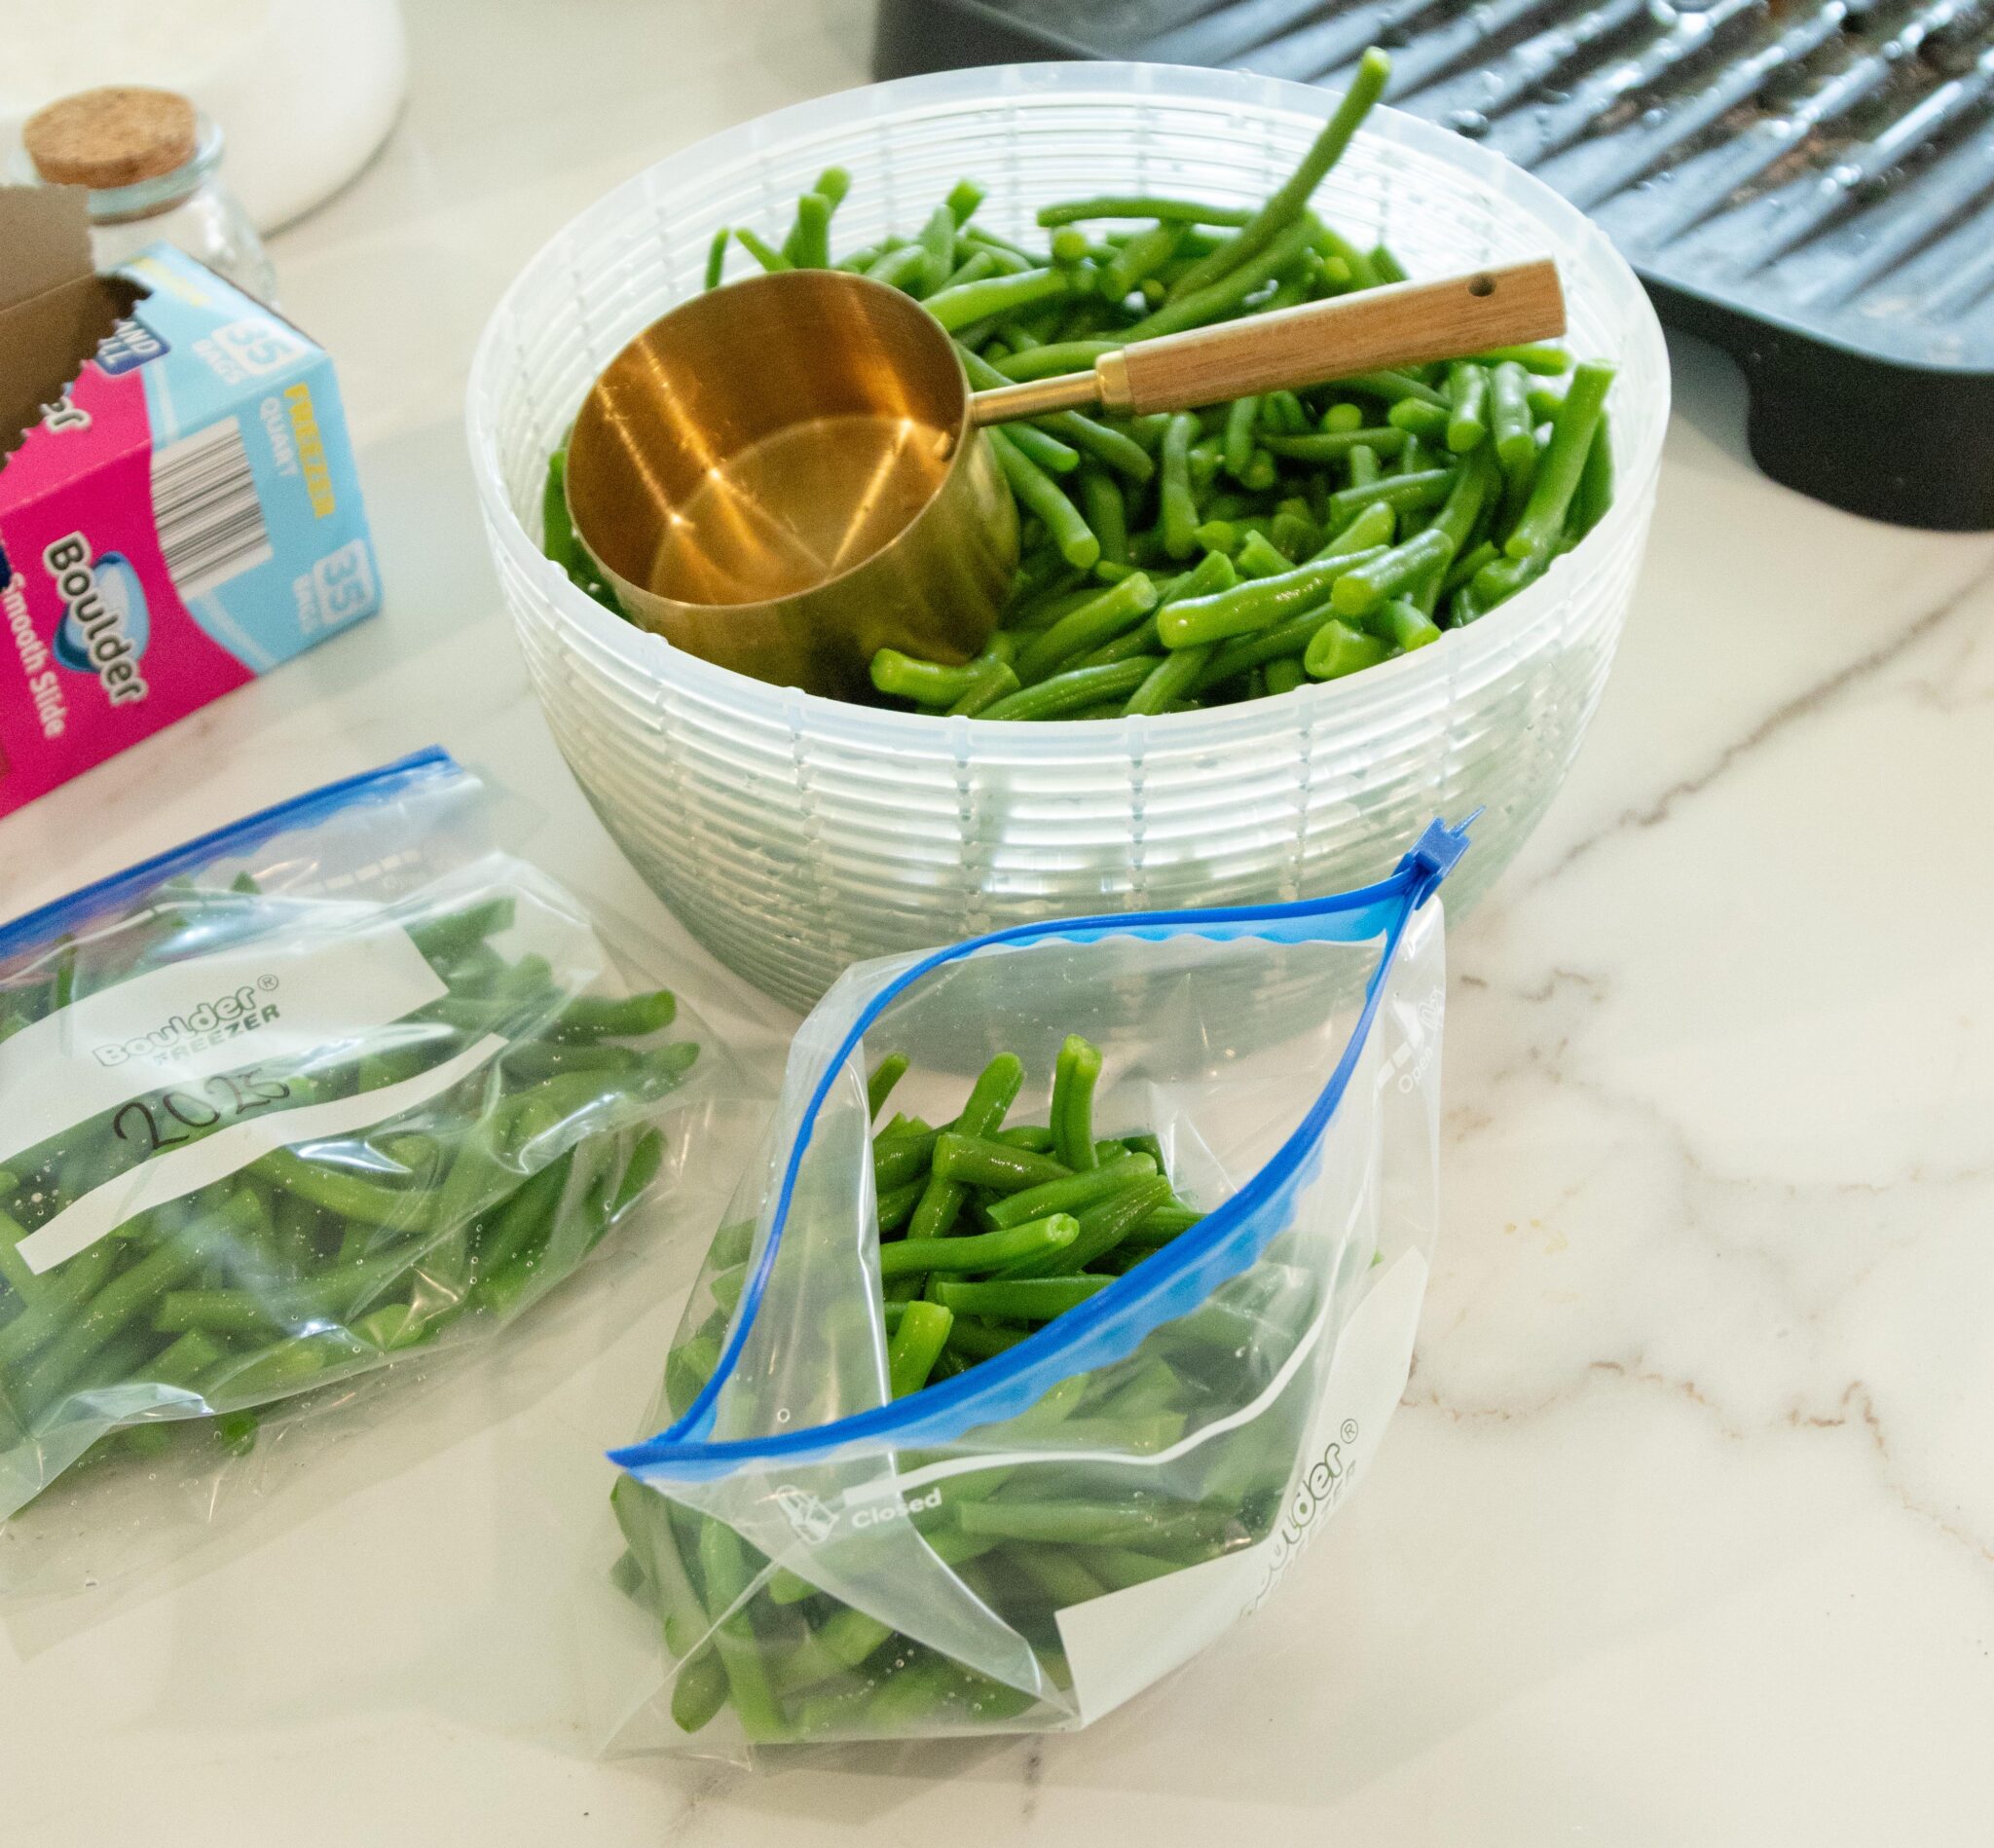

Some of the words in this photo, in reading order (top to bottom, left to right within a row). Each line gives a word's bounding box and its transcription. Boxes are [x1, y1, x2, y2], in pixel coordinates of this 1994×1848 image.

[259, 396, 299, 477] QUART
[284, 381, 336, 520] FREEZER
[45, 532, 146, 705] Boulder
[321, 549, 368, 612] 35
[3, 572, 49, 674] Smooth
[30, 671, 67, 739] Slide
[154, 1004, 280, 1066] FREEZER
[1398, 1046, 1434, 1094] Open
[112, 1067, 291, 1150] 2025
[851, 1486, 943, 1530] Closed
